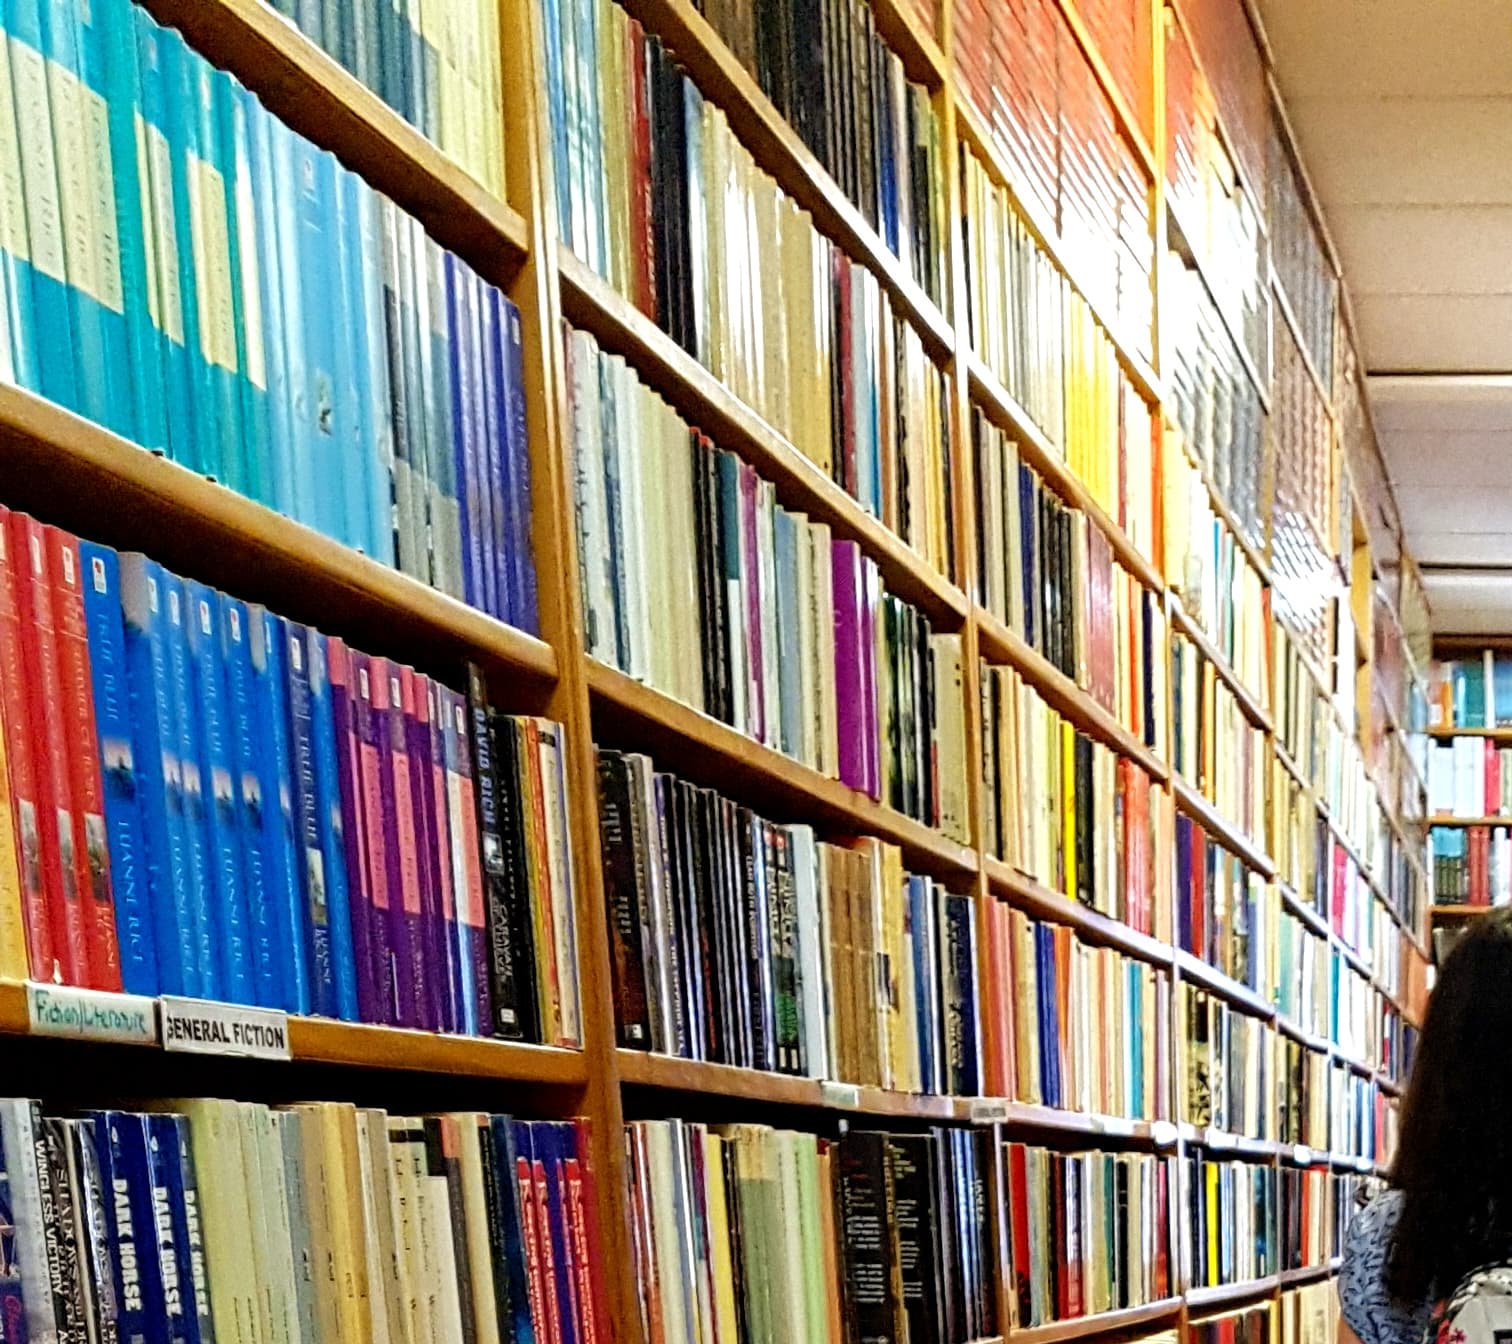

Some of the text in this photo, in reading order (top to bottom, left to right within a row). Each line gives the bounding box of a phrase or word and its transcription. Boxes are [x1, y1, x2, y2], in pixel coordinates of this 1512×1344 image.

[166, 1016, 285, 1049] GENERAL FICTION
[35, 1140, 64, 1295] WINGLESS VICTORY
[112, 1178, 143, 1312] DARK HORSE
[153, 1187, 183, 1317] DARK HORSE
[184, 1190, 210, 1316] DARK HORSE
